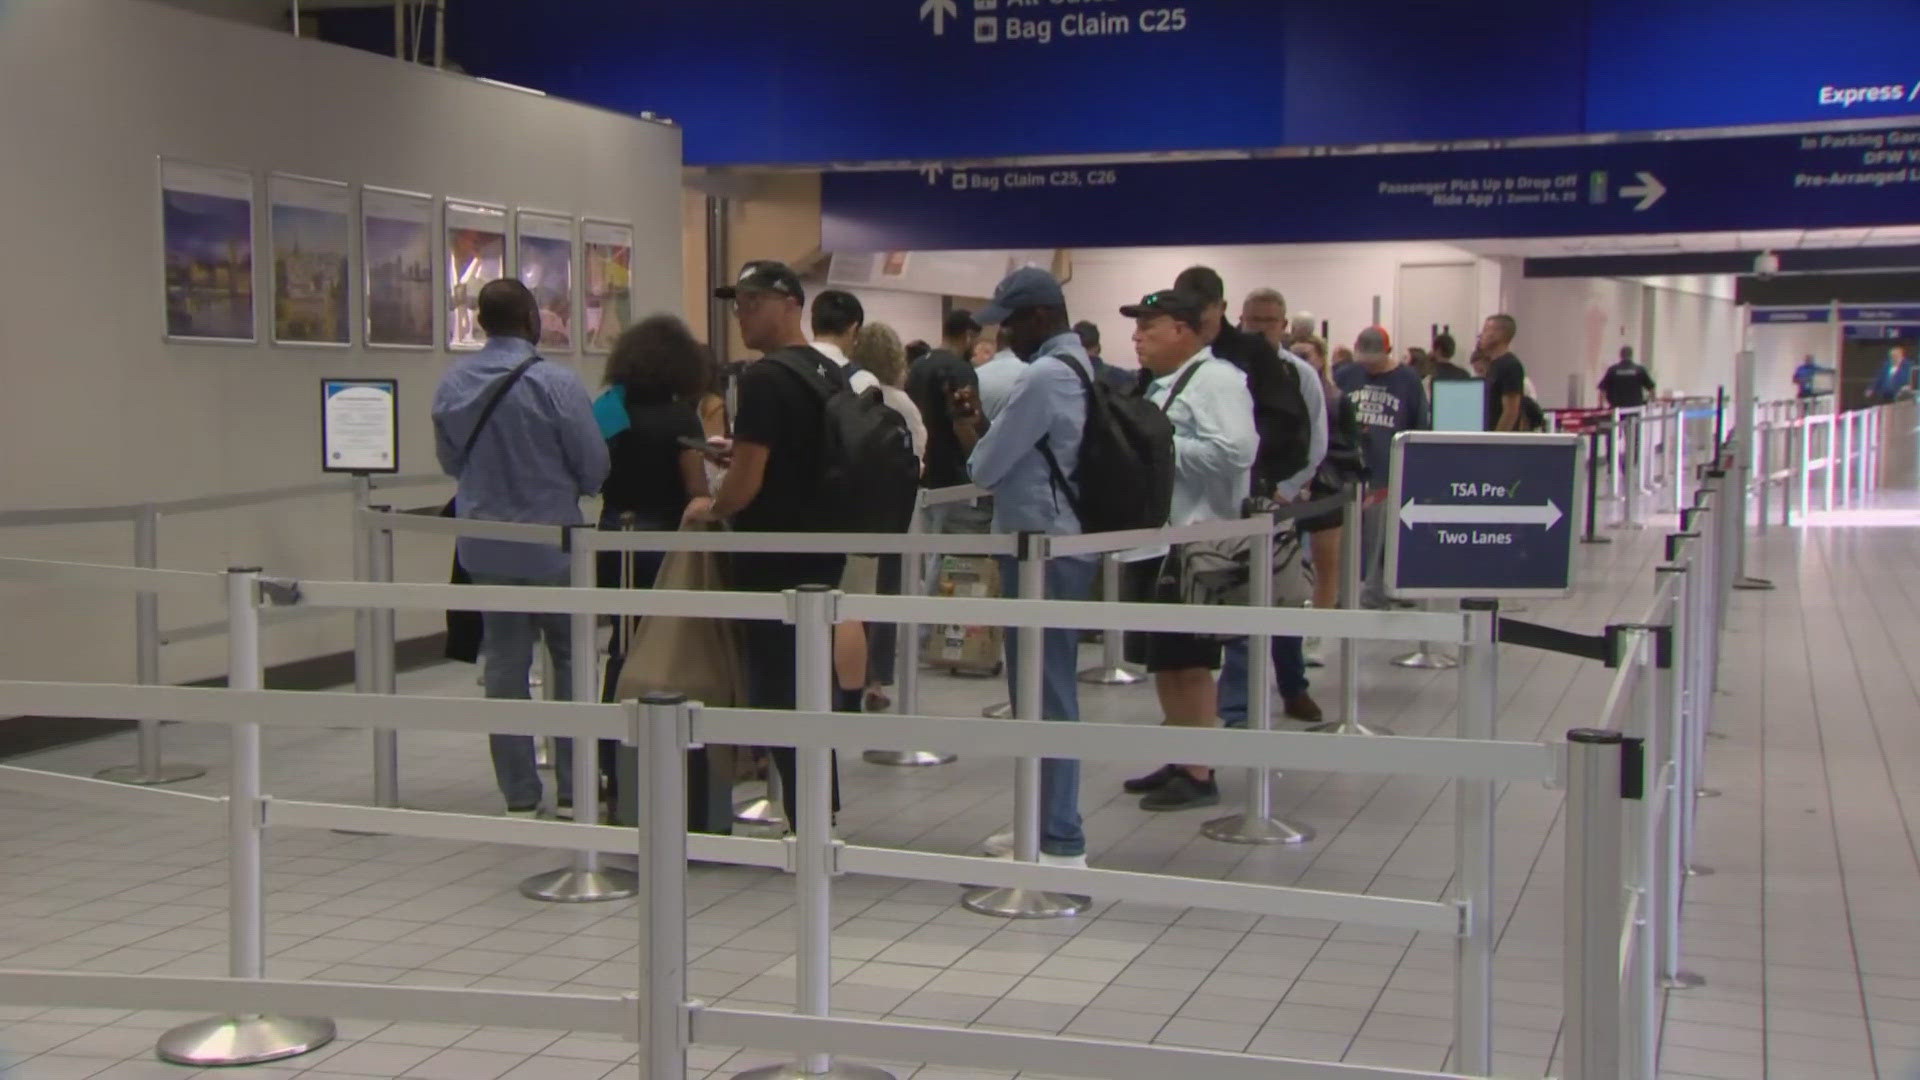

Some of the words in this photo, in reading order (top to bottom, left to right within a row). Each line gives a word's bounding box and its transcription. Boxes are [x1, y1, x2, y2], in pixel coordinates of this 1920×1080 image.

[1006, 17, 1051, 44] Bag
[1061, 12, 1129, 37] Claim
[1139, 8, 1187, 32] C25
[1818, 84, 1904, 107] Express
[1821, 134, 1884, 148] Parking
[1864, 150, 1904, 165] DFW
[971, 173, 999, 191] Bag
[1004, 172, 1045, 187] Claim
[1087, 170, 1117, 185] C26
[1378, 180, 1447, 195] Passenger
[1450, 178, 1479, 191] Pick
[1483, 177, 1501, 192] Up
[1517, 176, 1551, 190] Drop
[1554, 174, 1578, 188] Off
[1795, 168, 1906, 187] Pre-Arranged
[1466, 194, 1493, 207] App
[1348, 389, 1400, 411] OWBOYS
[1450, 483, 1477, 496] TSA
[1481, 483, 1506, 497] Pre
[1438, 530, 1468, 544] Two
[1472, 530, 1512, 545] Lanes
